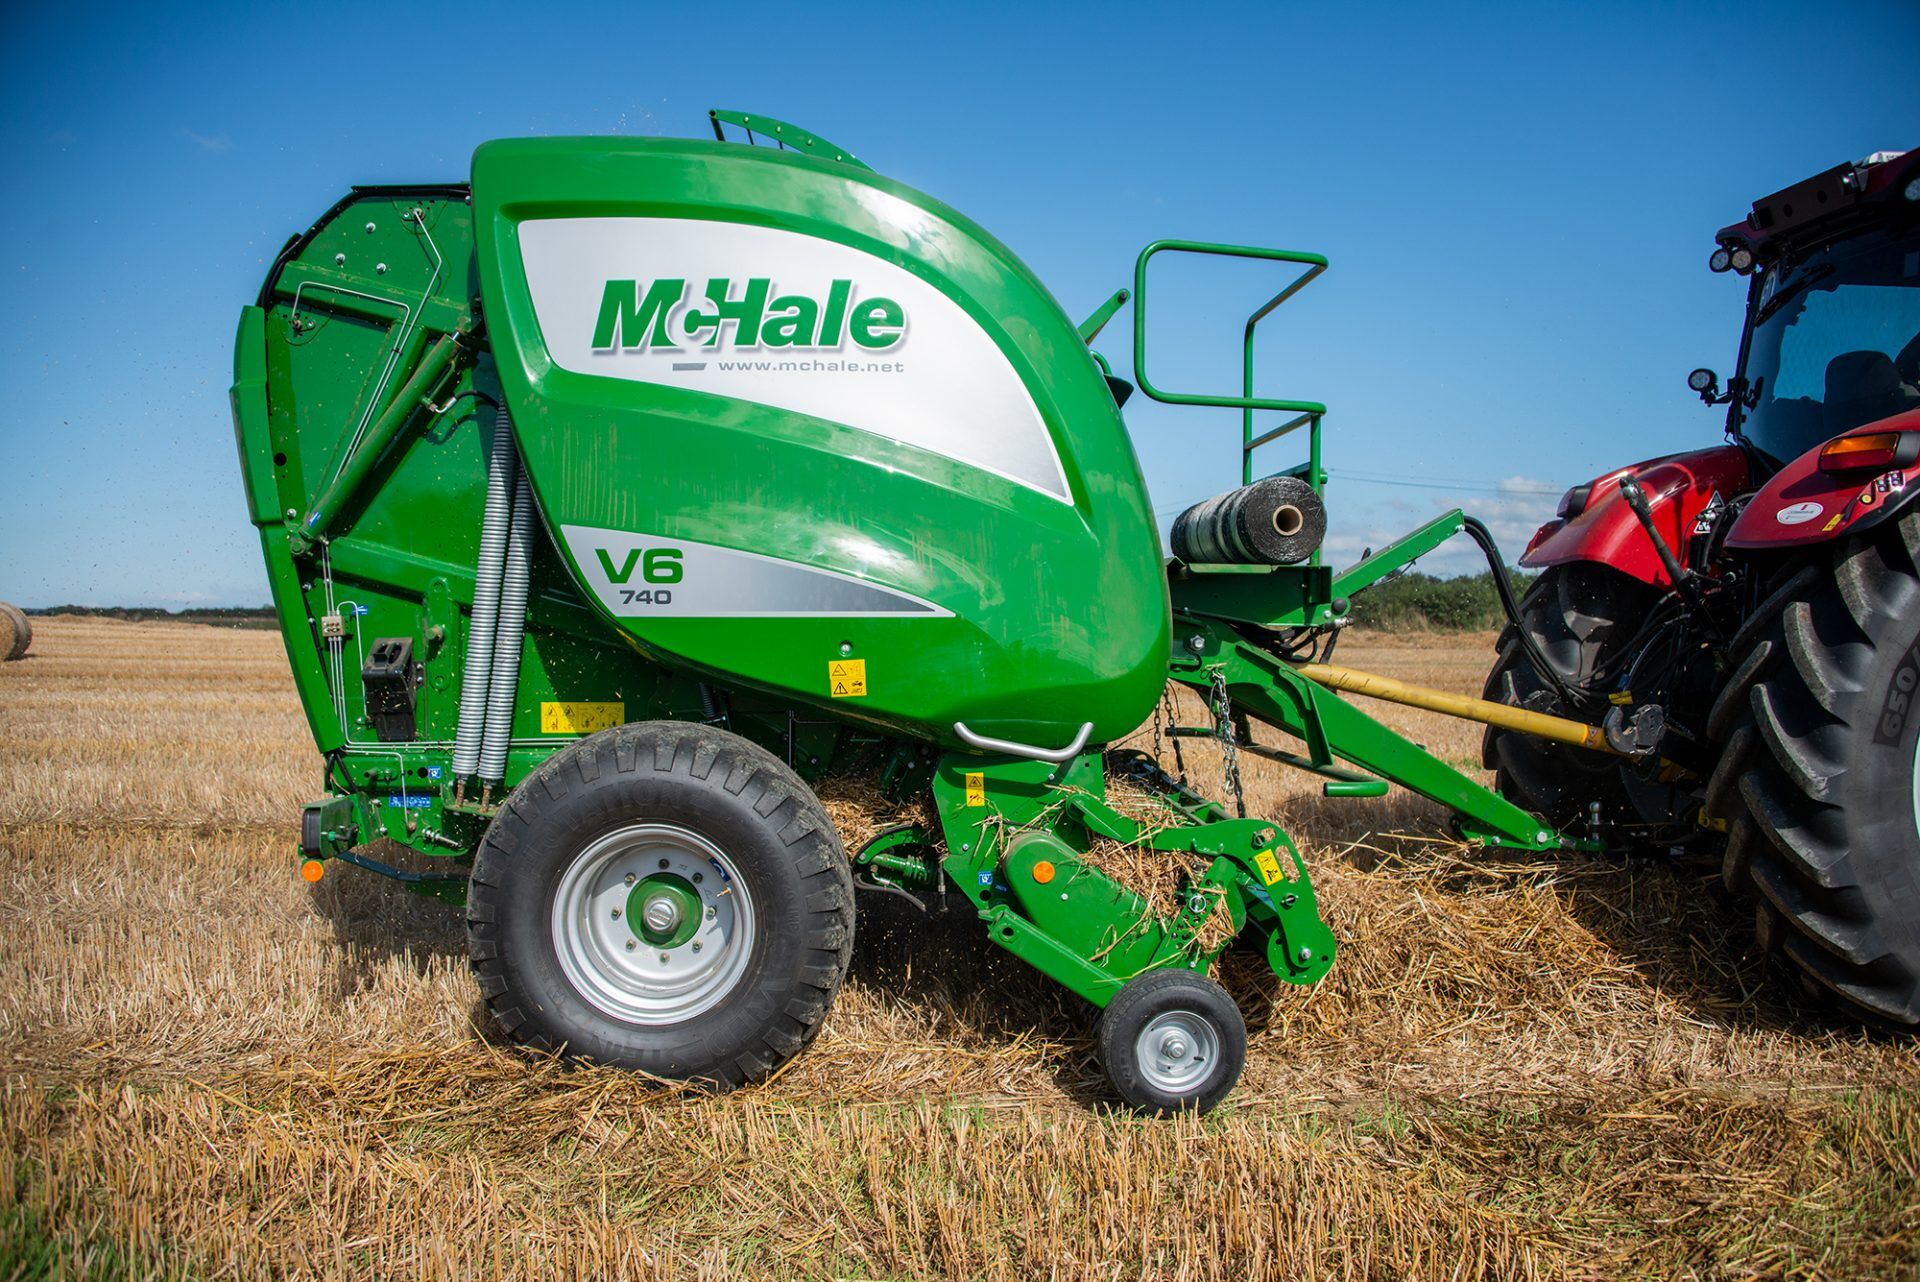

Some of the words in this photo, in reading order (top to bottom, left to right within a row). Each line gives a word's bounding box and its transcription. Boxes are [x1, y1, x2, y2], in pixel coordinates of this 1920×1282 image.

[591, 278, 906, 350] McHale
[718, 359, 905, 373] www.mchale.net
[595, 548, 683, 584] V6
[619, 590, 672, 605] 740
